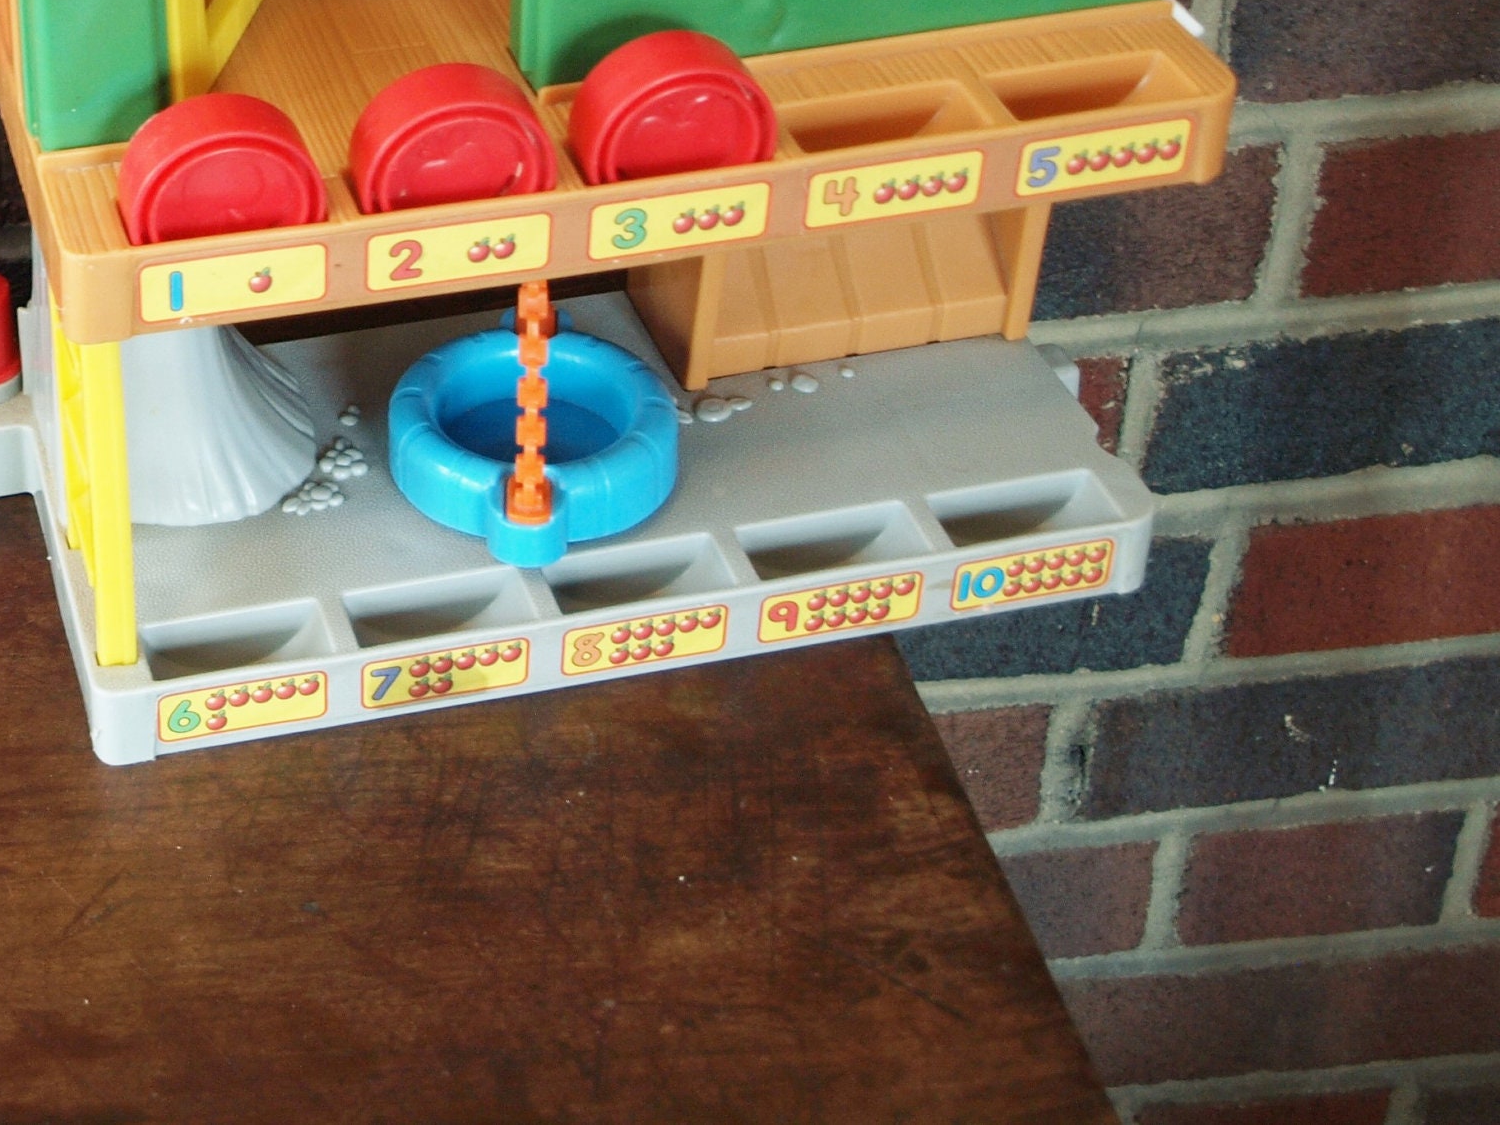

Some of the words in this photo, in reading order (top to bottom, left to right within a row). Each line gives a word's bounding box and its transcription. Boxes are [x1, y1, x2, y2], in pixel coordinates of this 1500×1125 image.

[1026, 146, 1062, 188] 5
[822, 176, 860, 216] 4
[611, 207, 648, 249] 3
[388, 238, 424, 281] 2
[169, 271, 183, 312] 1
[957, 567, 1005, 602] 10
[767, 600, 799, 632] 9
[571, 632, 605, 667] 8
[369, 666, 402, 701] 7
[167, 699, 201, 734] 6
